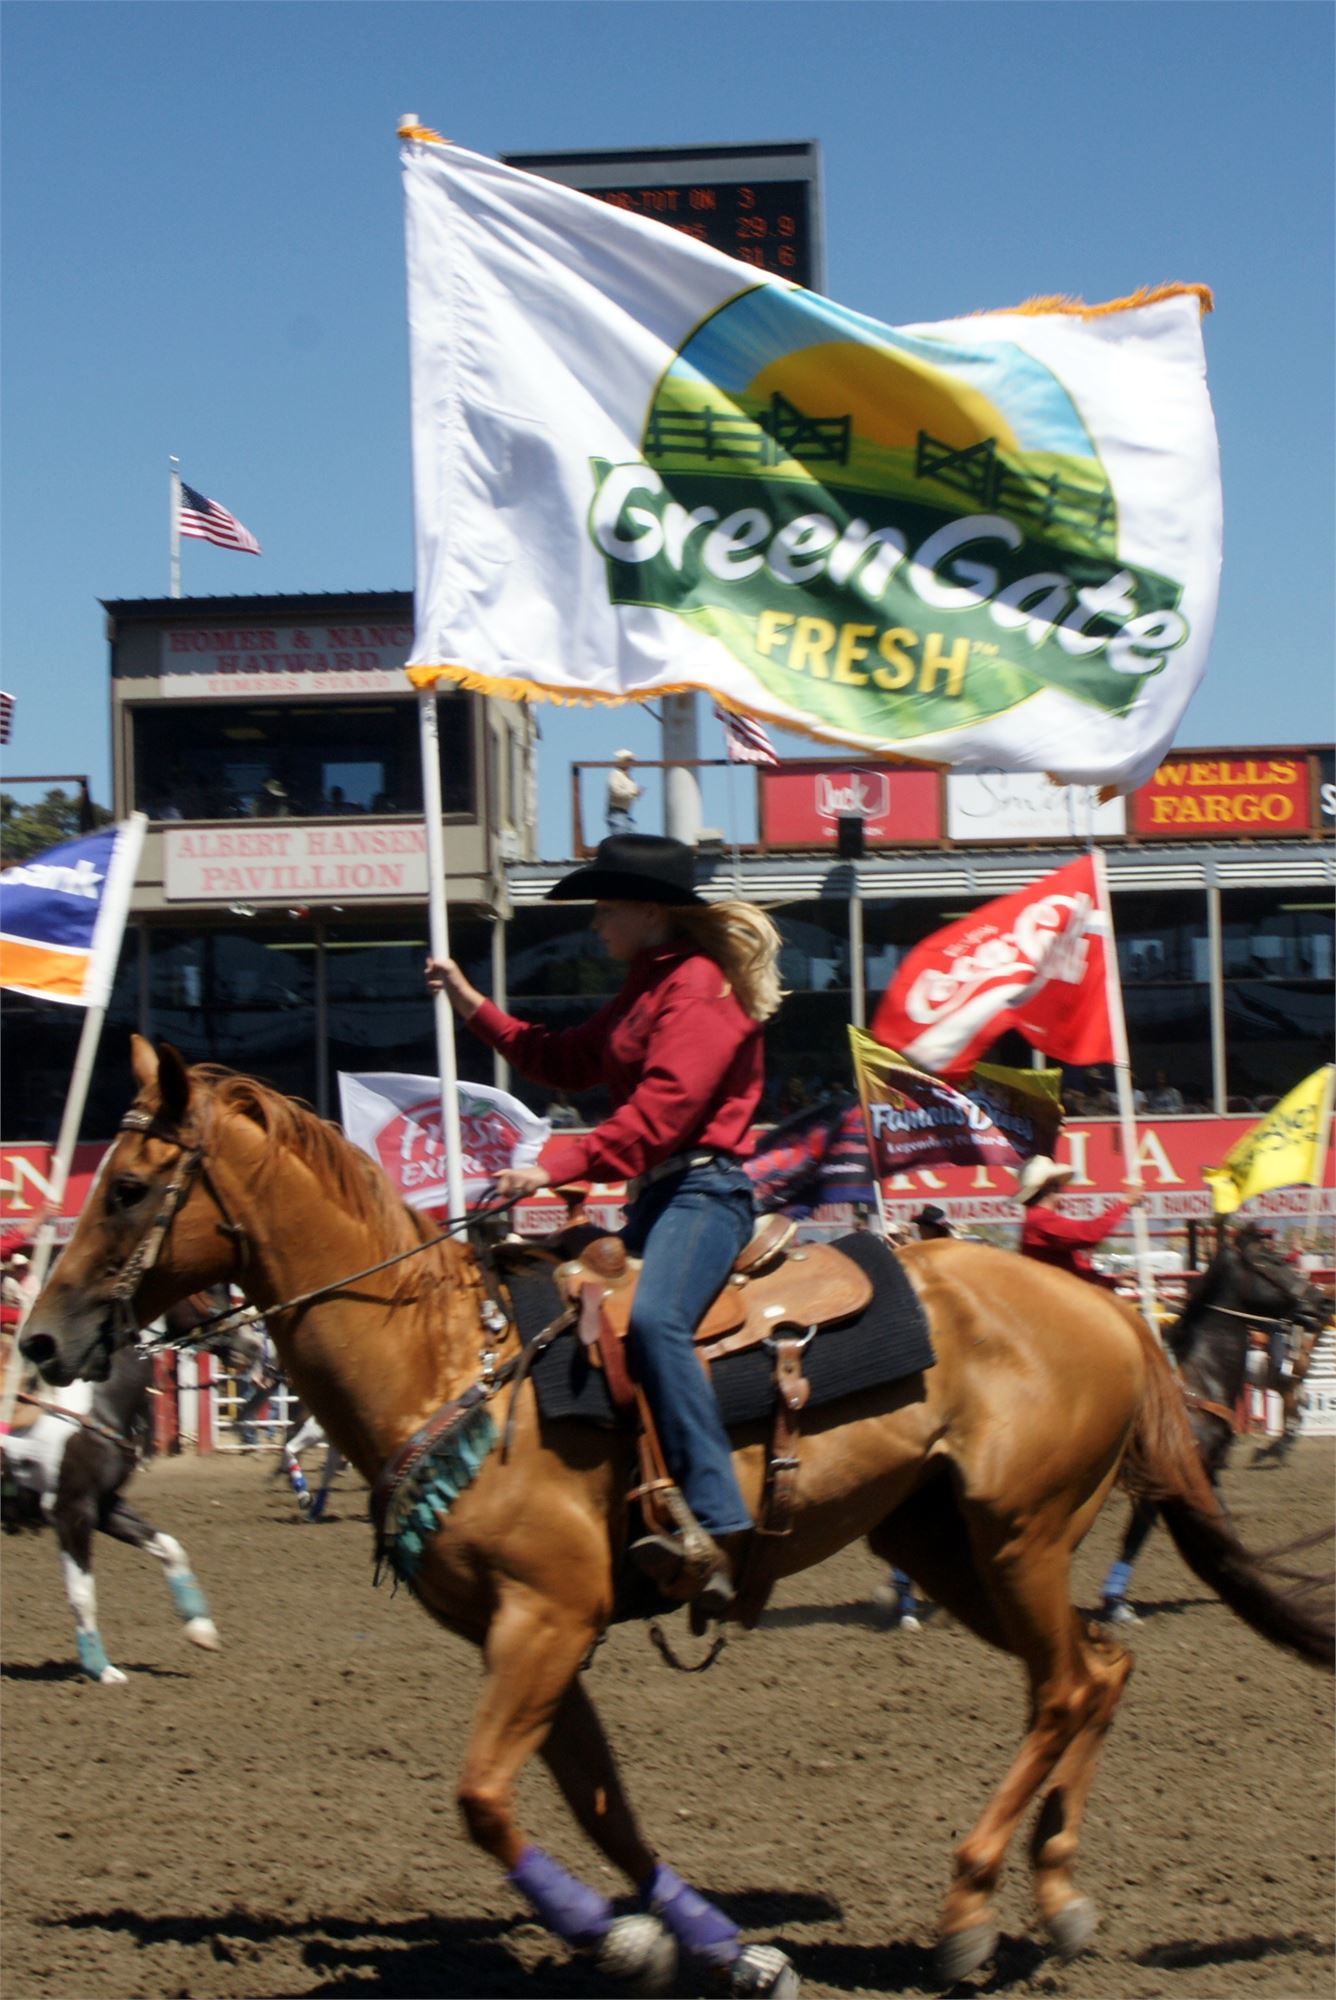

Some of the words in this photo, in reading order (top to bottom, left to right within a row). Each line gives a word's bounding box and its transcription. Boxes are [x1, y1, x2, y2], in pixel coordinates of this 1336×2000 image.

[170, 629, 278, 653] HOMER
[327, 625, 415, 648] NANC
[755, 609, 972, 697] FRESH
[217, 652, 381, 673] HAYWARD
[1152, 760, 1299, 787] WELLS
[1149, 793, 1295, 824] FARGO
[177, 833, 293, 857] ALBERT
[307, 829, 428, 855] HANSEN
[201, 863, 405, 892] PAVILLION
[904, 892, 1092, 1025] Coca-C
[869, 1103, 966, 1140] Famous
[400, 1116, 506, 1161] Frsh
[947, 1201, 1024, 1222] MARKE
